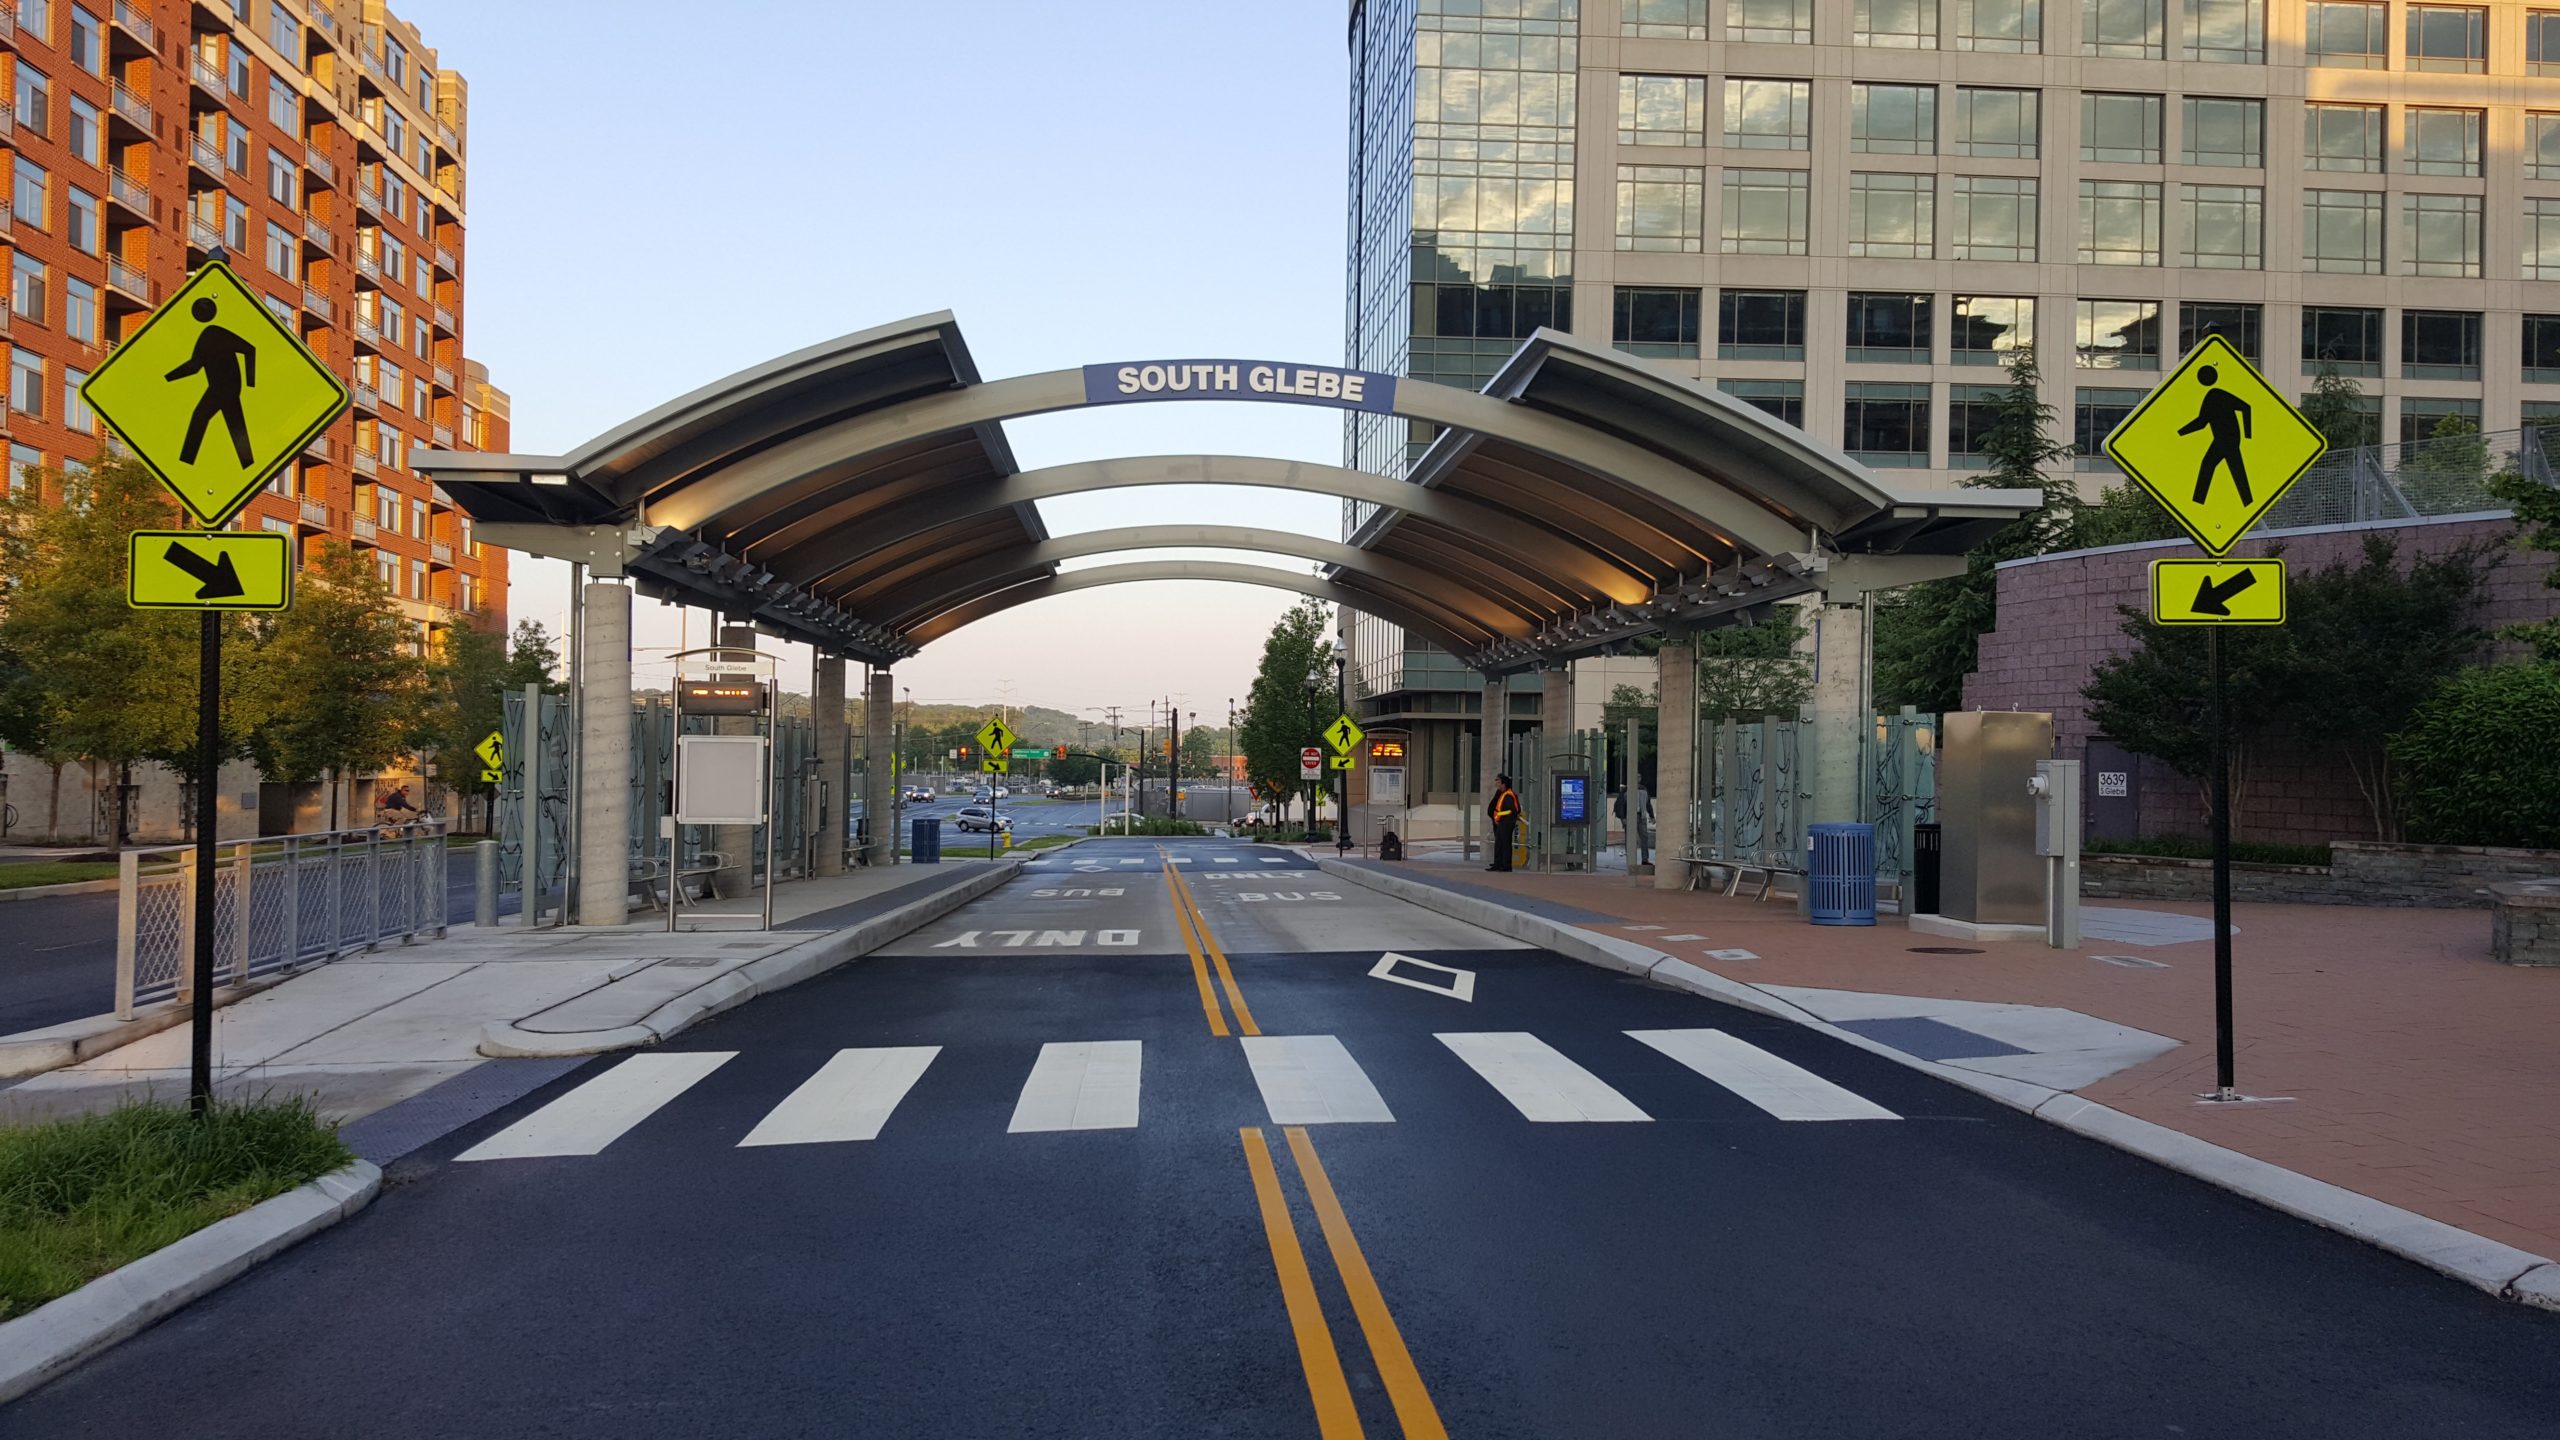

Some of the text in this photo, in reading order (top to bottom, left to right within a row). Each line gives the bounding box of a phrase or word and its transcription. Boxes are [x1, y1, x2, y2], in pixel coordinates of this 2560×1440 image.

[1117, 365, 1365, 402] SOUTH GLEBE
[2100, 774, 2125, 785] 3639
[1031, 888, 1125, 897] BUS
[1238, 892, 1342, 901] BUS
[930, 929, 1141, 948] ONLY
